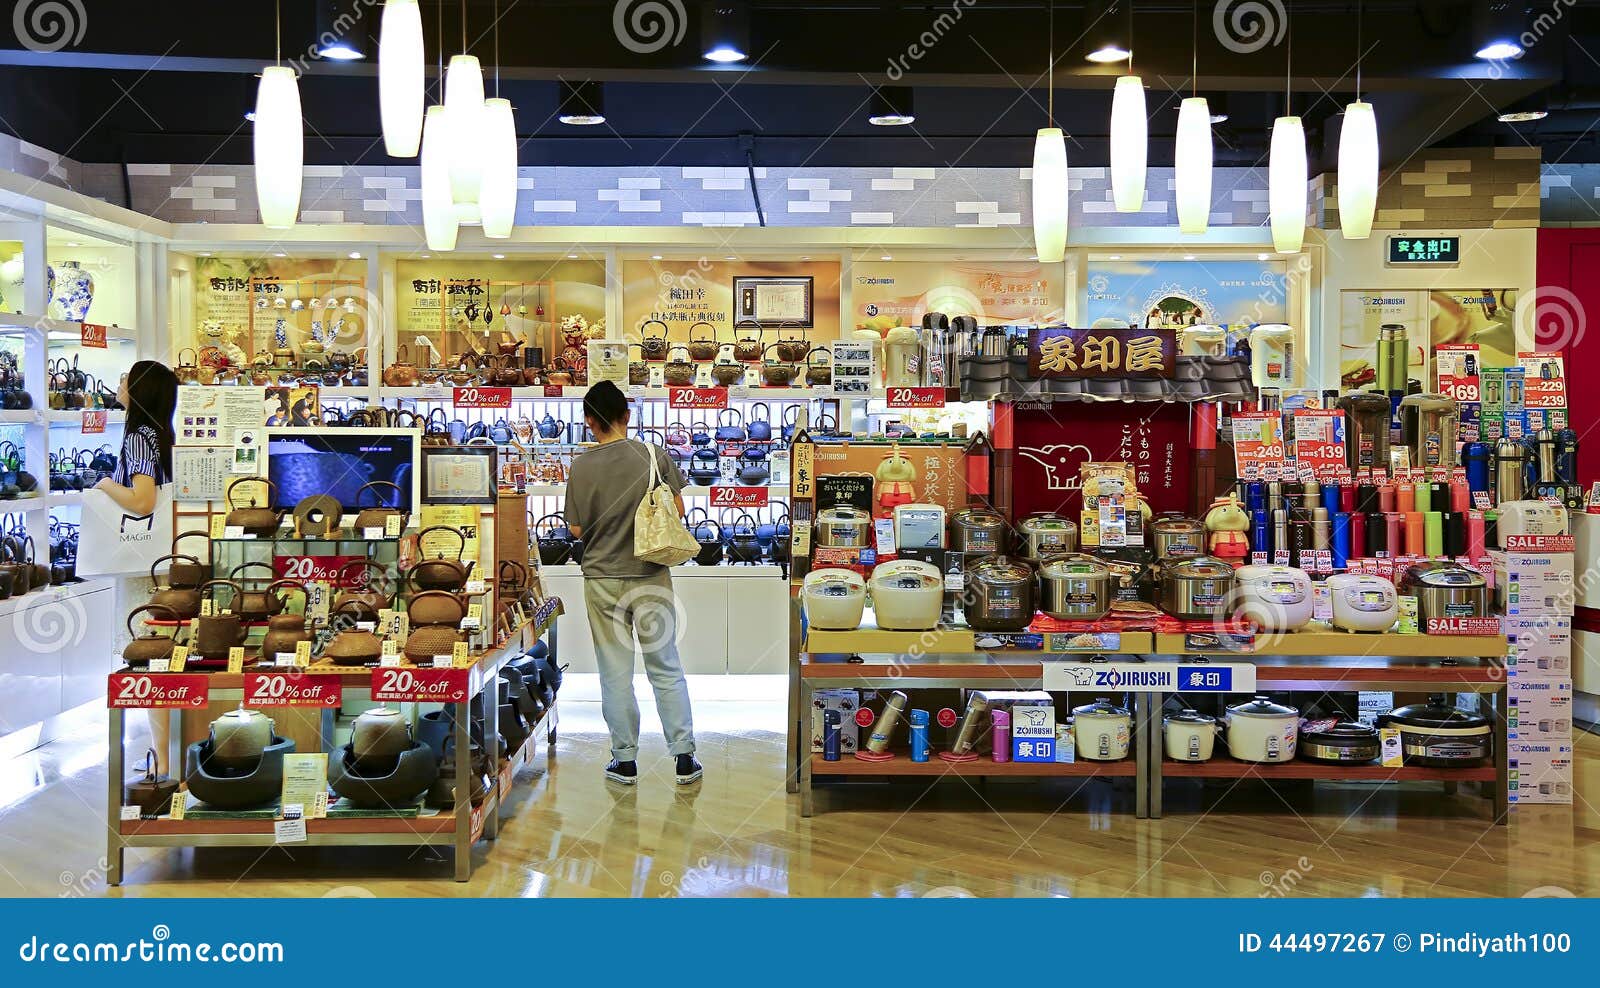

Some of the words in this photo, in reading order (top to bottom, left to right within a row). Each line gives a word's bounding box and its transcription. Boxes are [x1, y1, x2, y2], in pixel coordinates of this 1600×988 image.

[1398, 240, 1450, 252] 安全出口
[1408, 252, 1440, 260] EXIT
[1038, 335, 1165, 373] 象印屋
[458, 389, 486, 402] 20%
[487, 394, 500, 402] off
[675, 390, 702, 403] 20%
[704, 395, 716, 403] off
[892, 389, 920, 402] 20%
[921, 394, 934, 402] off
[1017, 402, 1052, 410] ZOJIRUSHI
[1120, 424, 1132, 463] こだわ
[1138, 417, 1151, 484] いいもの一筋
[796, 468, 810, 496] 象印
[715, 488, 743, 501] 20%
[744, 493, 757, 501] off
[1508, 536, 1545, 547] SALE
[284, 557, 326, 579] 20%
[1521, 558, 1551, 567] ZOJIRUSHI
[1429, 619, 1467, 630] SALE
[380, 670, 426, 692] 20%
[429, 681, 449, 693] off
[1095, 669, 1170, 688] ZOJIRUSHI
[1190, 672, 1221, 687] 象印
[119, 676, 164, 699] 20%
[168, 687, 189, 699] off
[254, 676, 299, 698] 20%
[302, 686, 322, 698] off
[1016, 727, 1053, 736] ZOJIRUSHI
[1018, 741, 1051, 758] 象印
